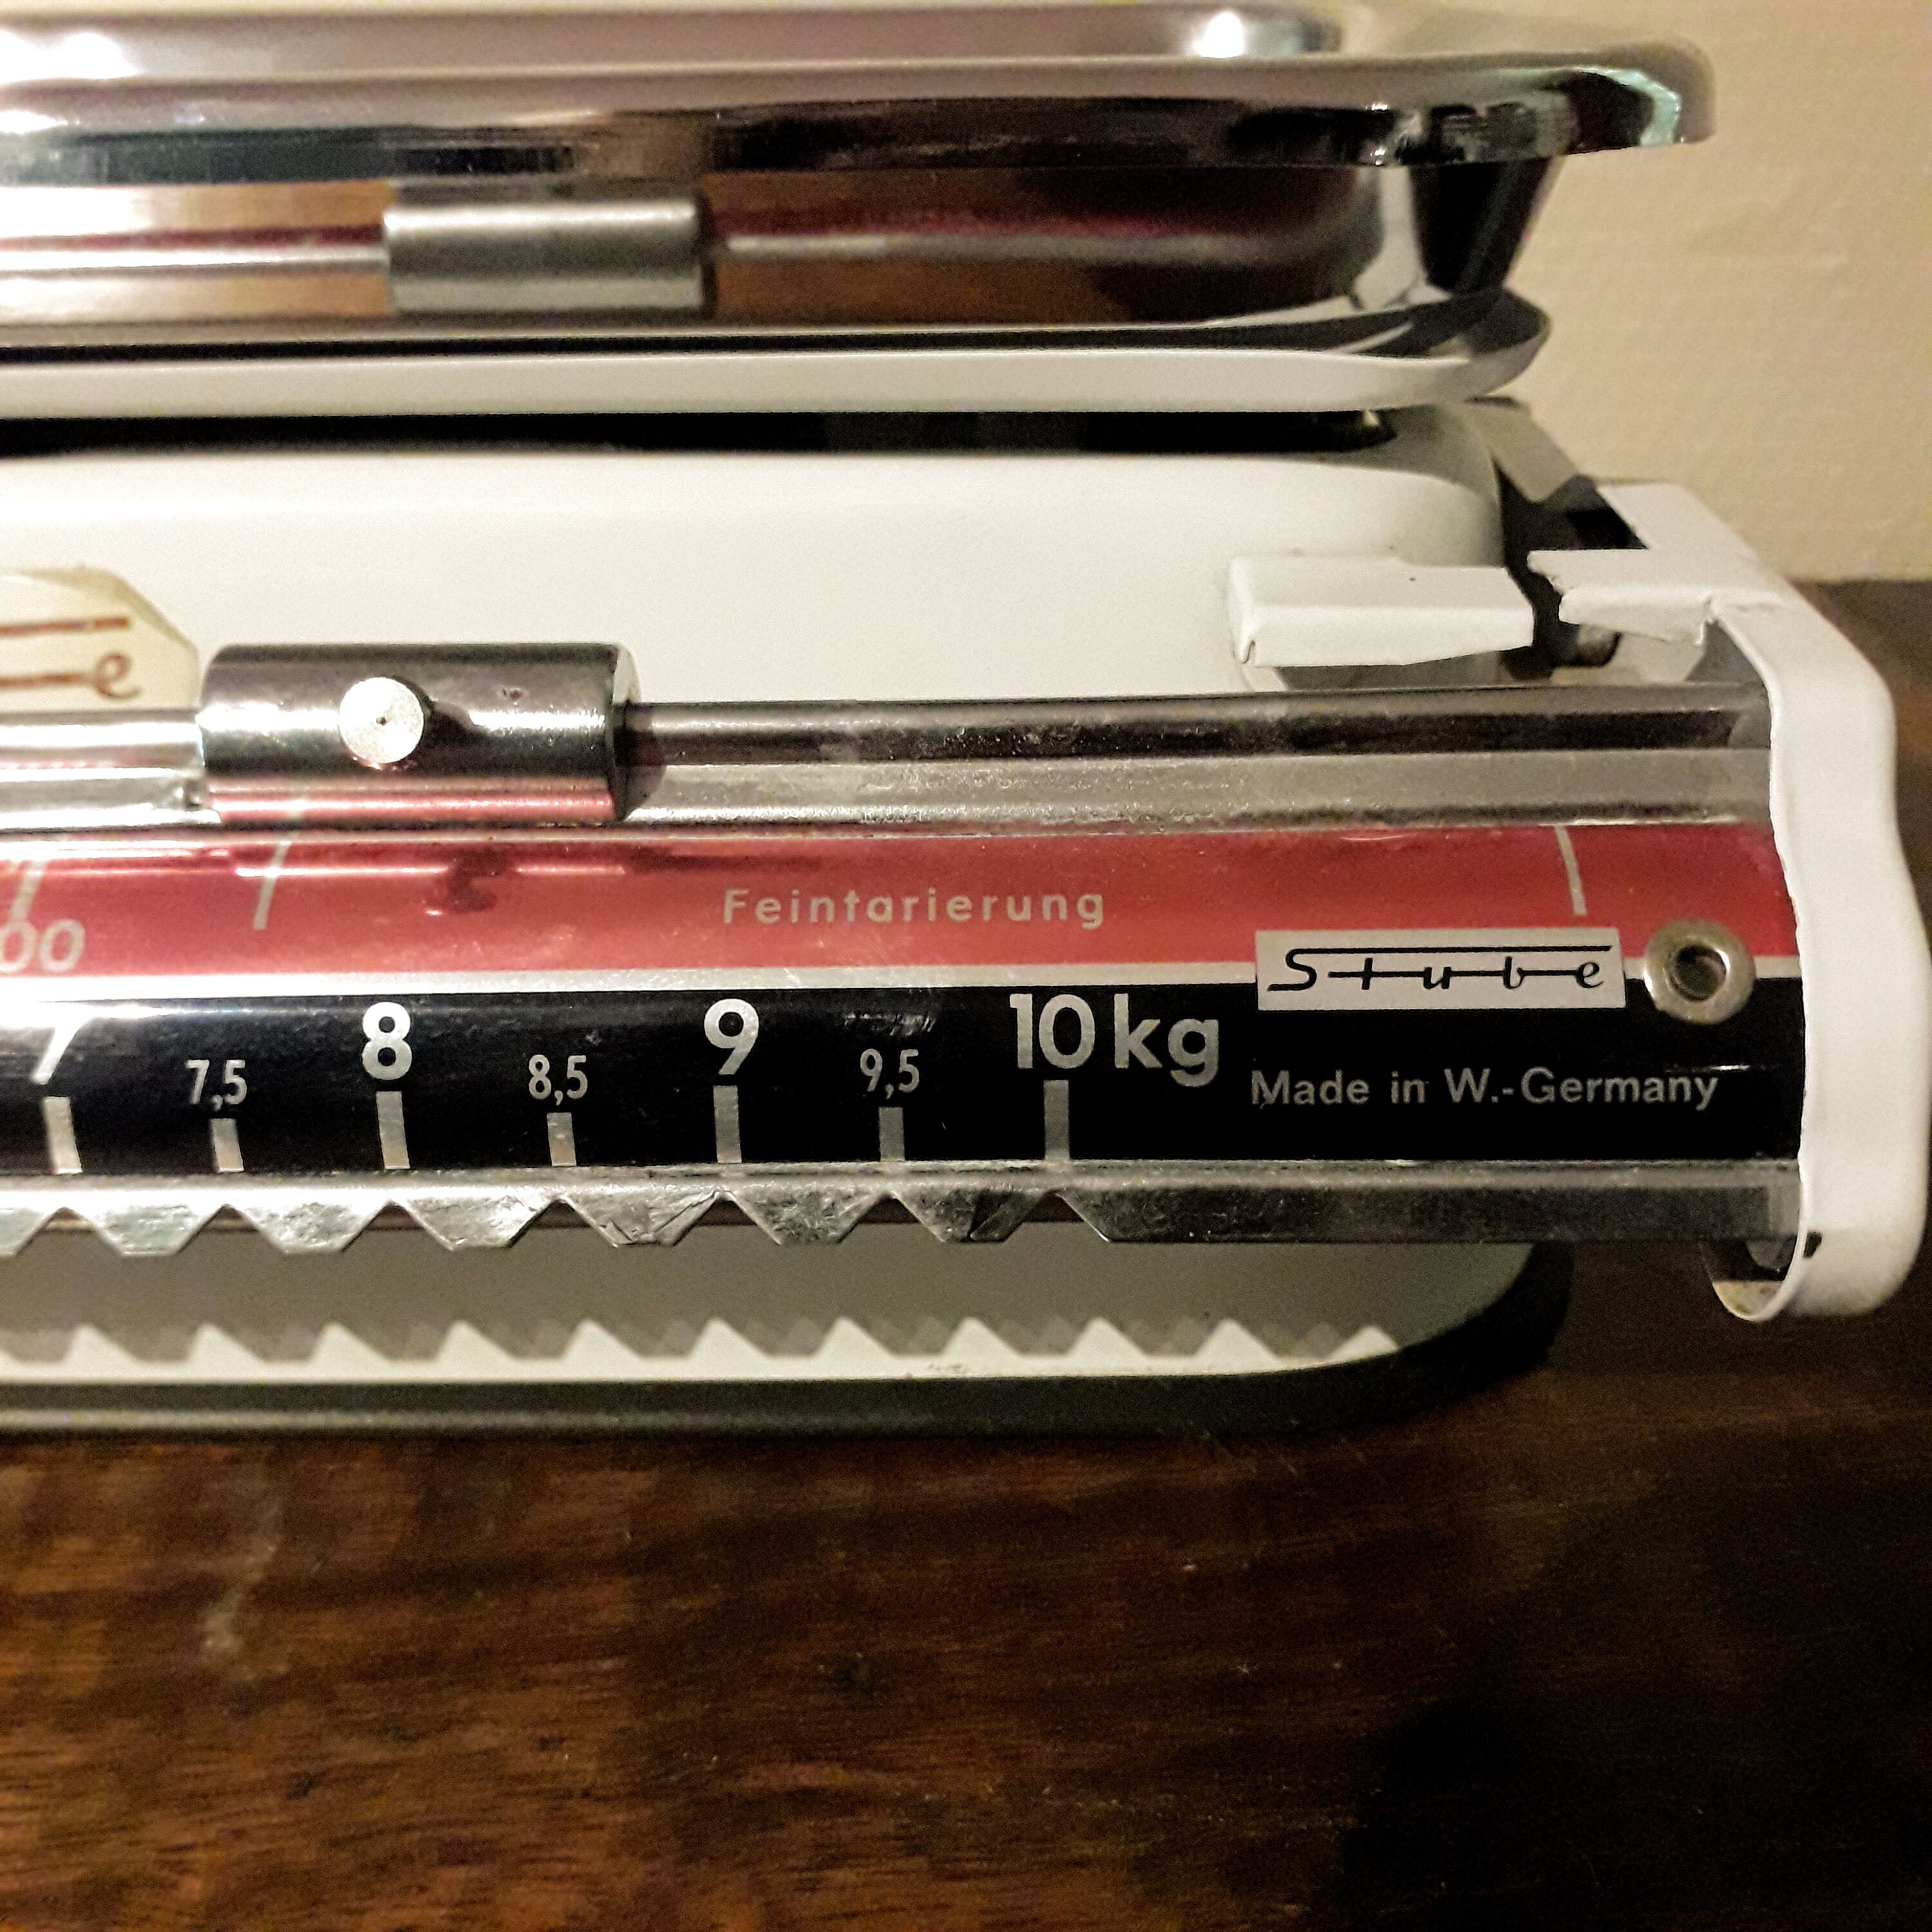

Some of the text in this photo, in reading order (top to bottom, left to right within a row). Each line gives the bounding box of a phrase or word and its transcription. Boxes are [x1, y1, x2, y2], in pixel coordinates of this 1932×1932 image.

[723, 889, 1103, 929] Feintarierung
[1267, 944, 1612, 992] Stube
[29, 1005, 91, 1084] 7
[361, 1001, 413, 1081] 8
[704, 998, 760, 1075] 9
[1009, 992, 1220, 1088] 10 kg
[185, 1059, 247, 1111] 7,5
[528, 1054, 589, 1106] 8,5
[859, 1048, 920, 1099] 9,5
[1251, 1069, 1370, 1106] Made
[1391, 1070, 1426, 1104] in
